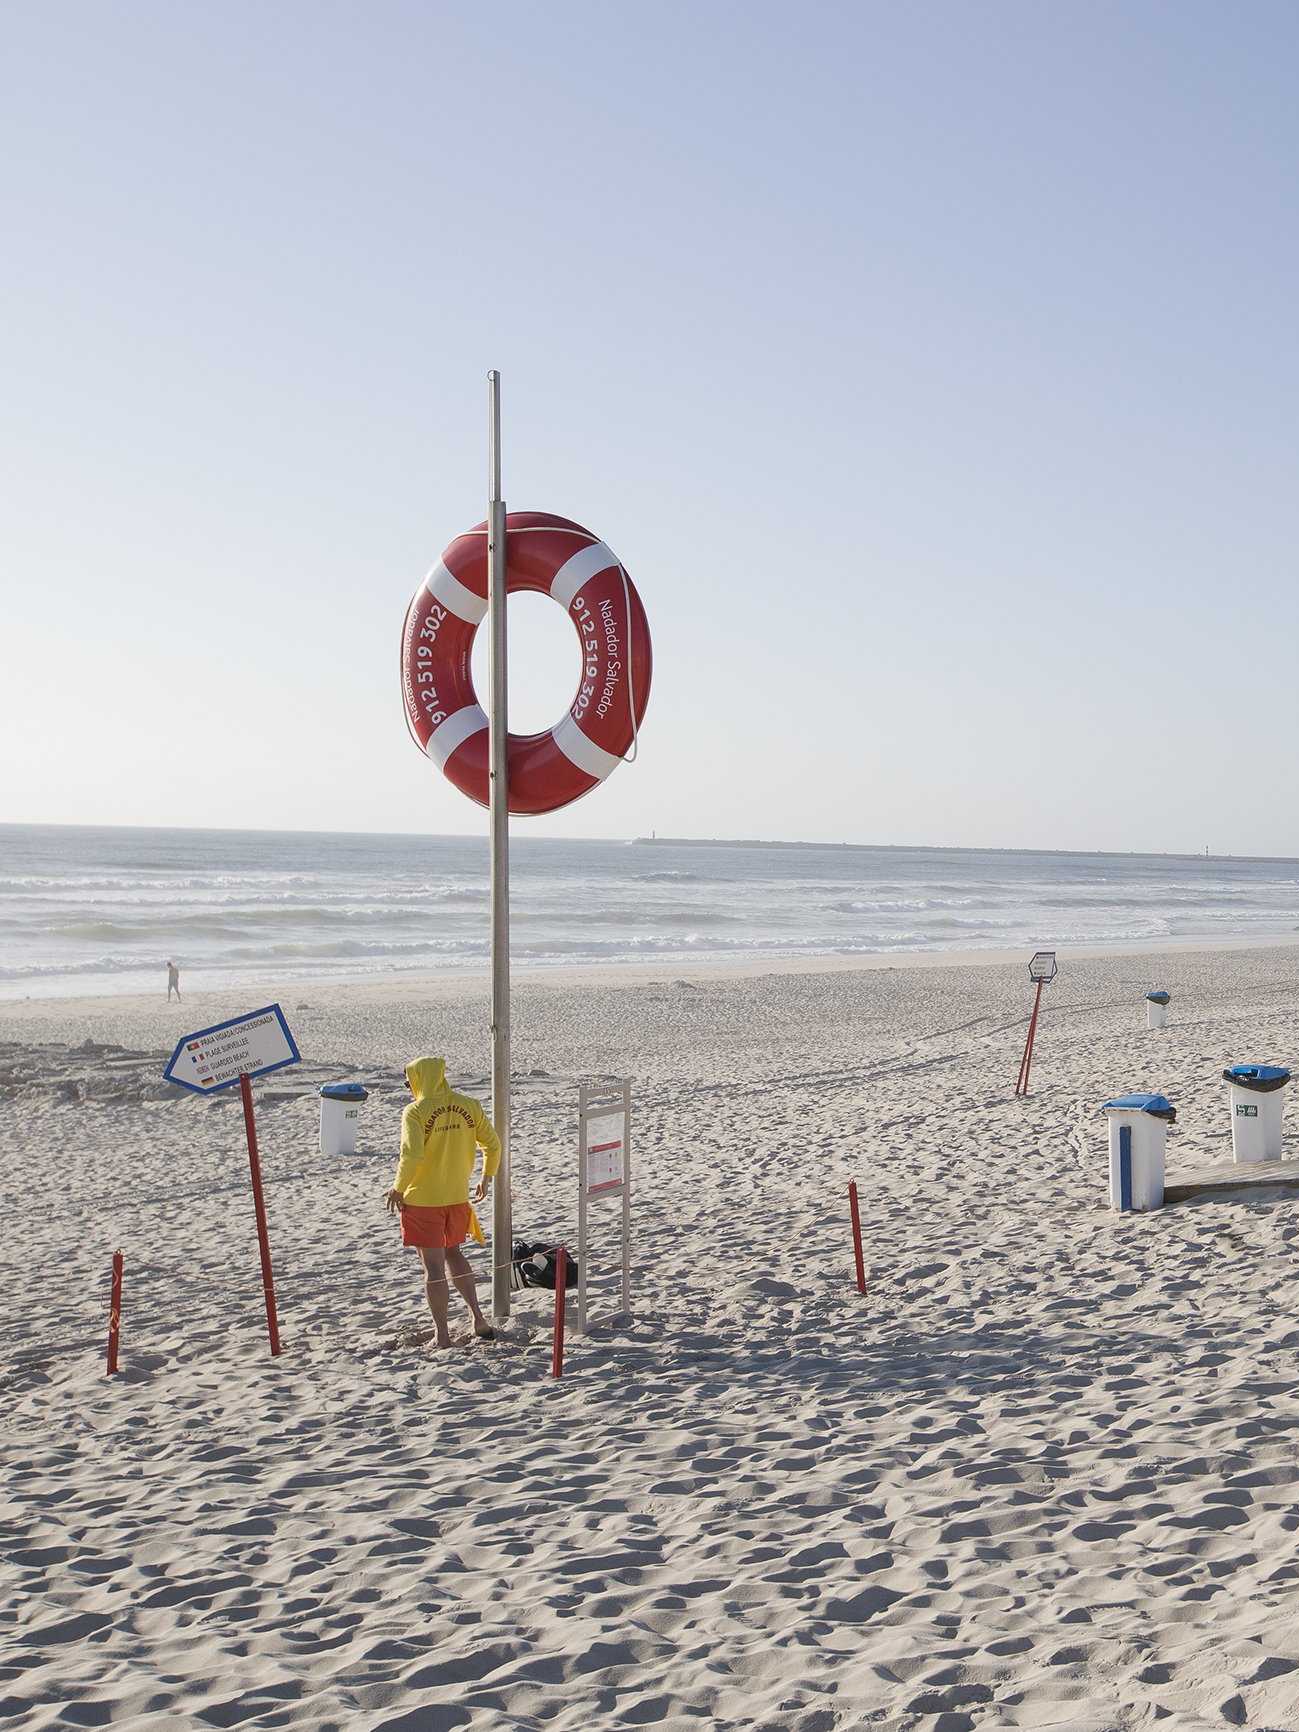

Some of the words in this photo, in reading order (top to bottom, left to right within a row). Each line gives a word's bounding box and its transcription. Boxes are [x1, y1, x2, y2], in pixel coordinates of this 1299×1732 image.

[420, 604, 447, 642] 302
[572, 596, 595, 635] 912
[598, 599, 620, 658] Nadador
[417, 646, 433, 683] 519
[585, 639, 599, 678] 519
[404, 668, 420, 723] Nadador
[421, 687, 447, 724] 912
[571, 681, 595, 720] 302
[596, 661, 621, 719] Salvador
[200, 1036, 216, 1047] PRAIA
[205, 1047, 222, 1058] PLAGE
[210, 1056, 234, 1070] GUARDED
[233, 1050, 250, 1062] BEACH
[215, 1066, 244, 1081] BEWACHTER
[243, 1059, 264, 1071] STRAND
[425, 1106, 446, 1134] NADADOR
[447, 1105, 475, 1129] SALVADOR
